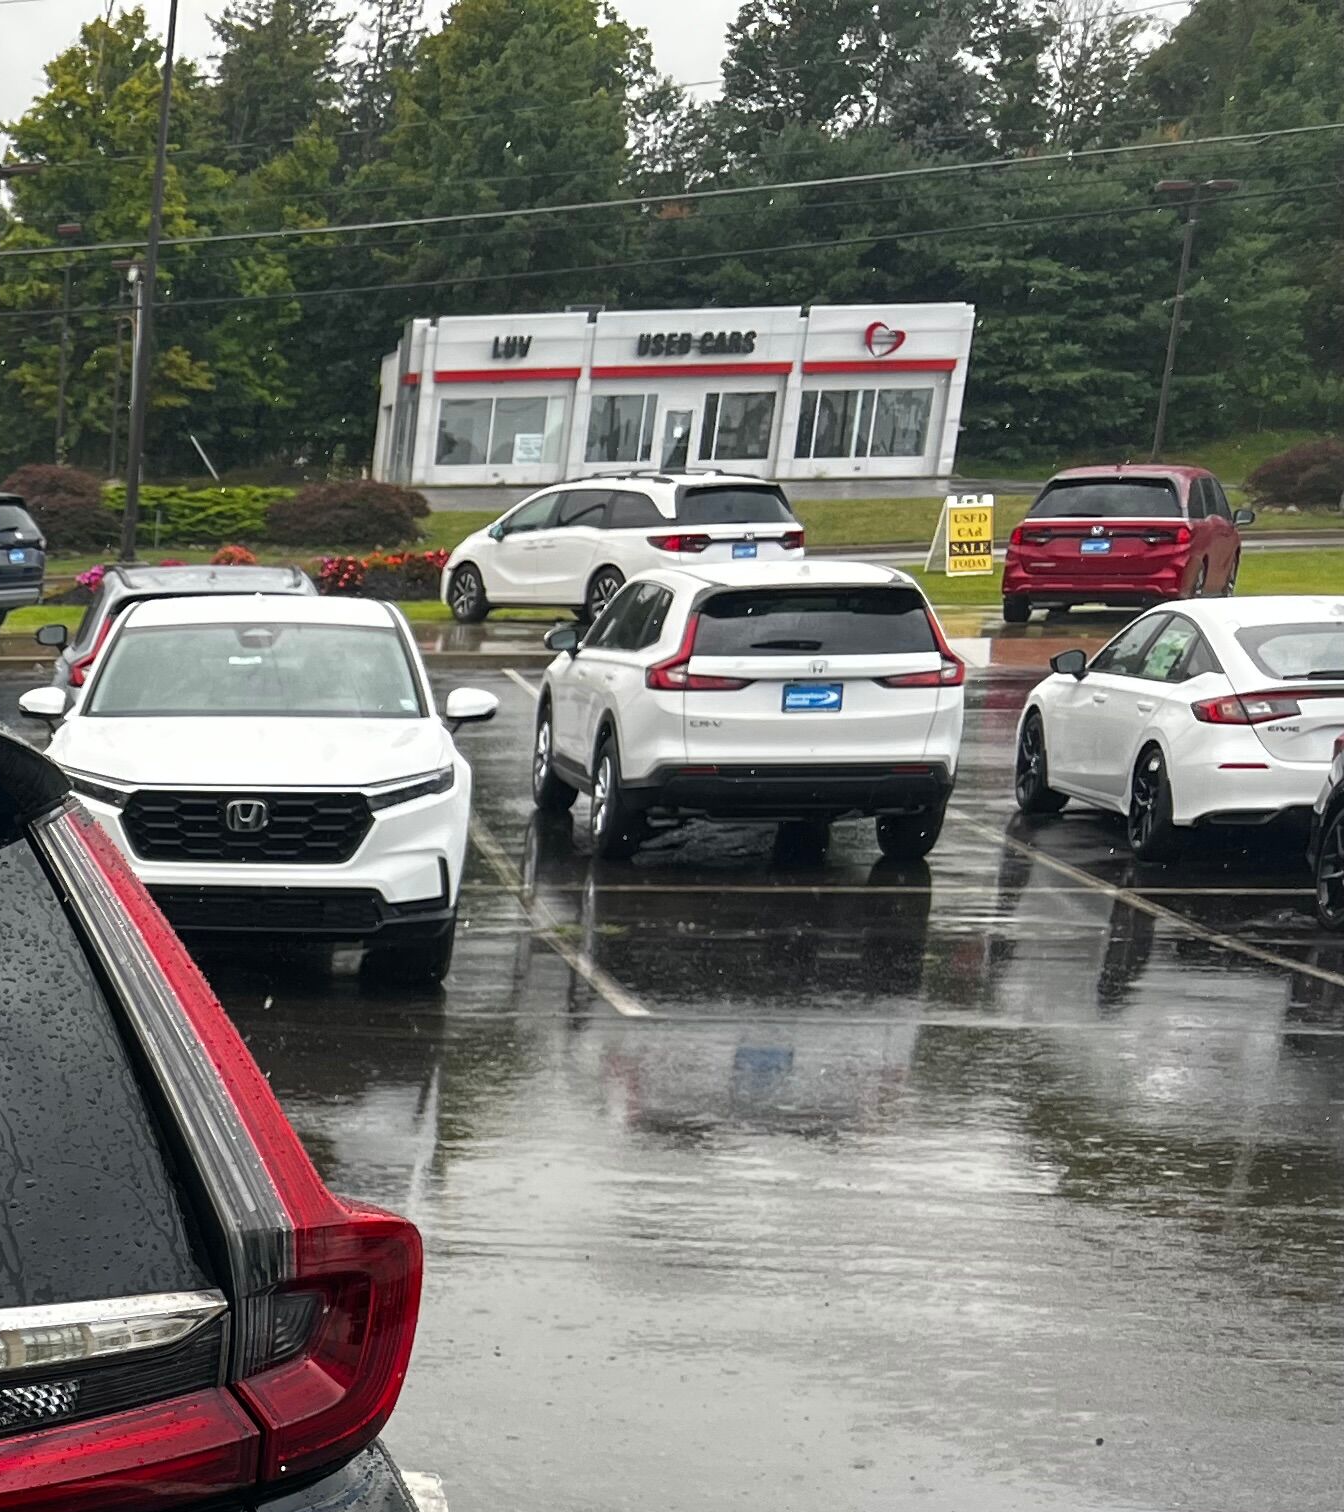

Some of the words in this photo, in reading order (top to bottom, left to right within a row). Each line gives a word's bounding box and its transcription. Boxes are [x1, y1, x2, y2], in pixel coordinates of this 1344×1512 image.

[491, 334, 533, 359] LUV
[636, 332, 693, 358] USED
[698, 330, 758, 355] CARS
[954, 512, 988, 524] USED
[957, 527, 983, 538] CAR
[951, 542, 989, 555] SALE
[953, 558, 987, 569] TODAY
